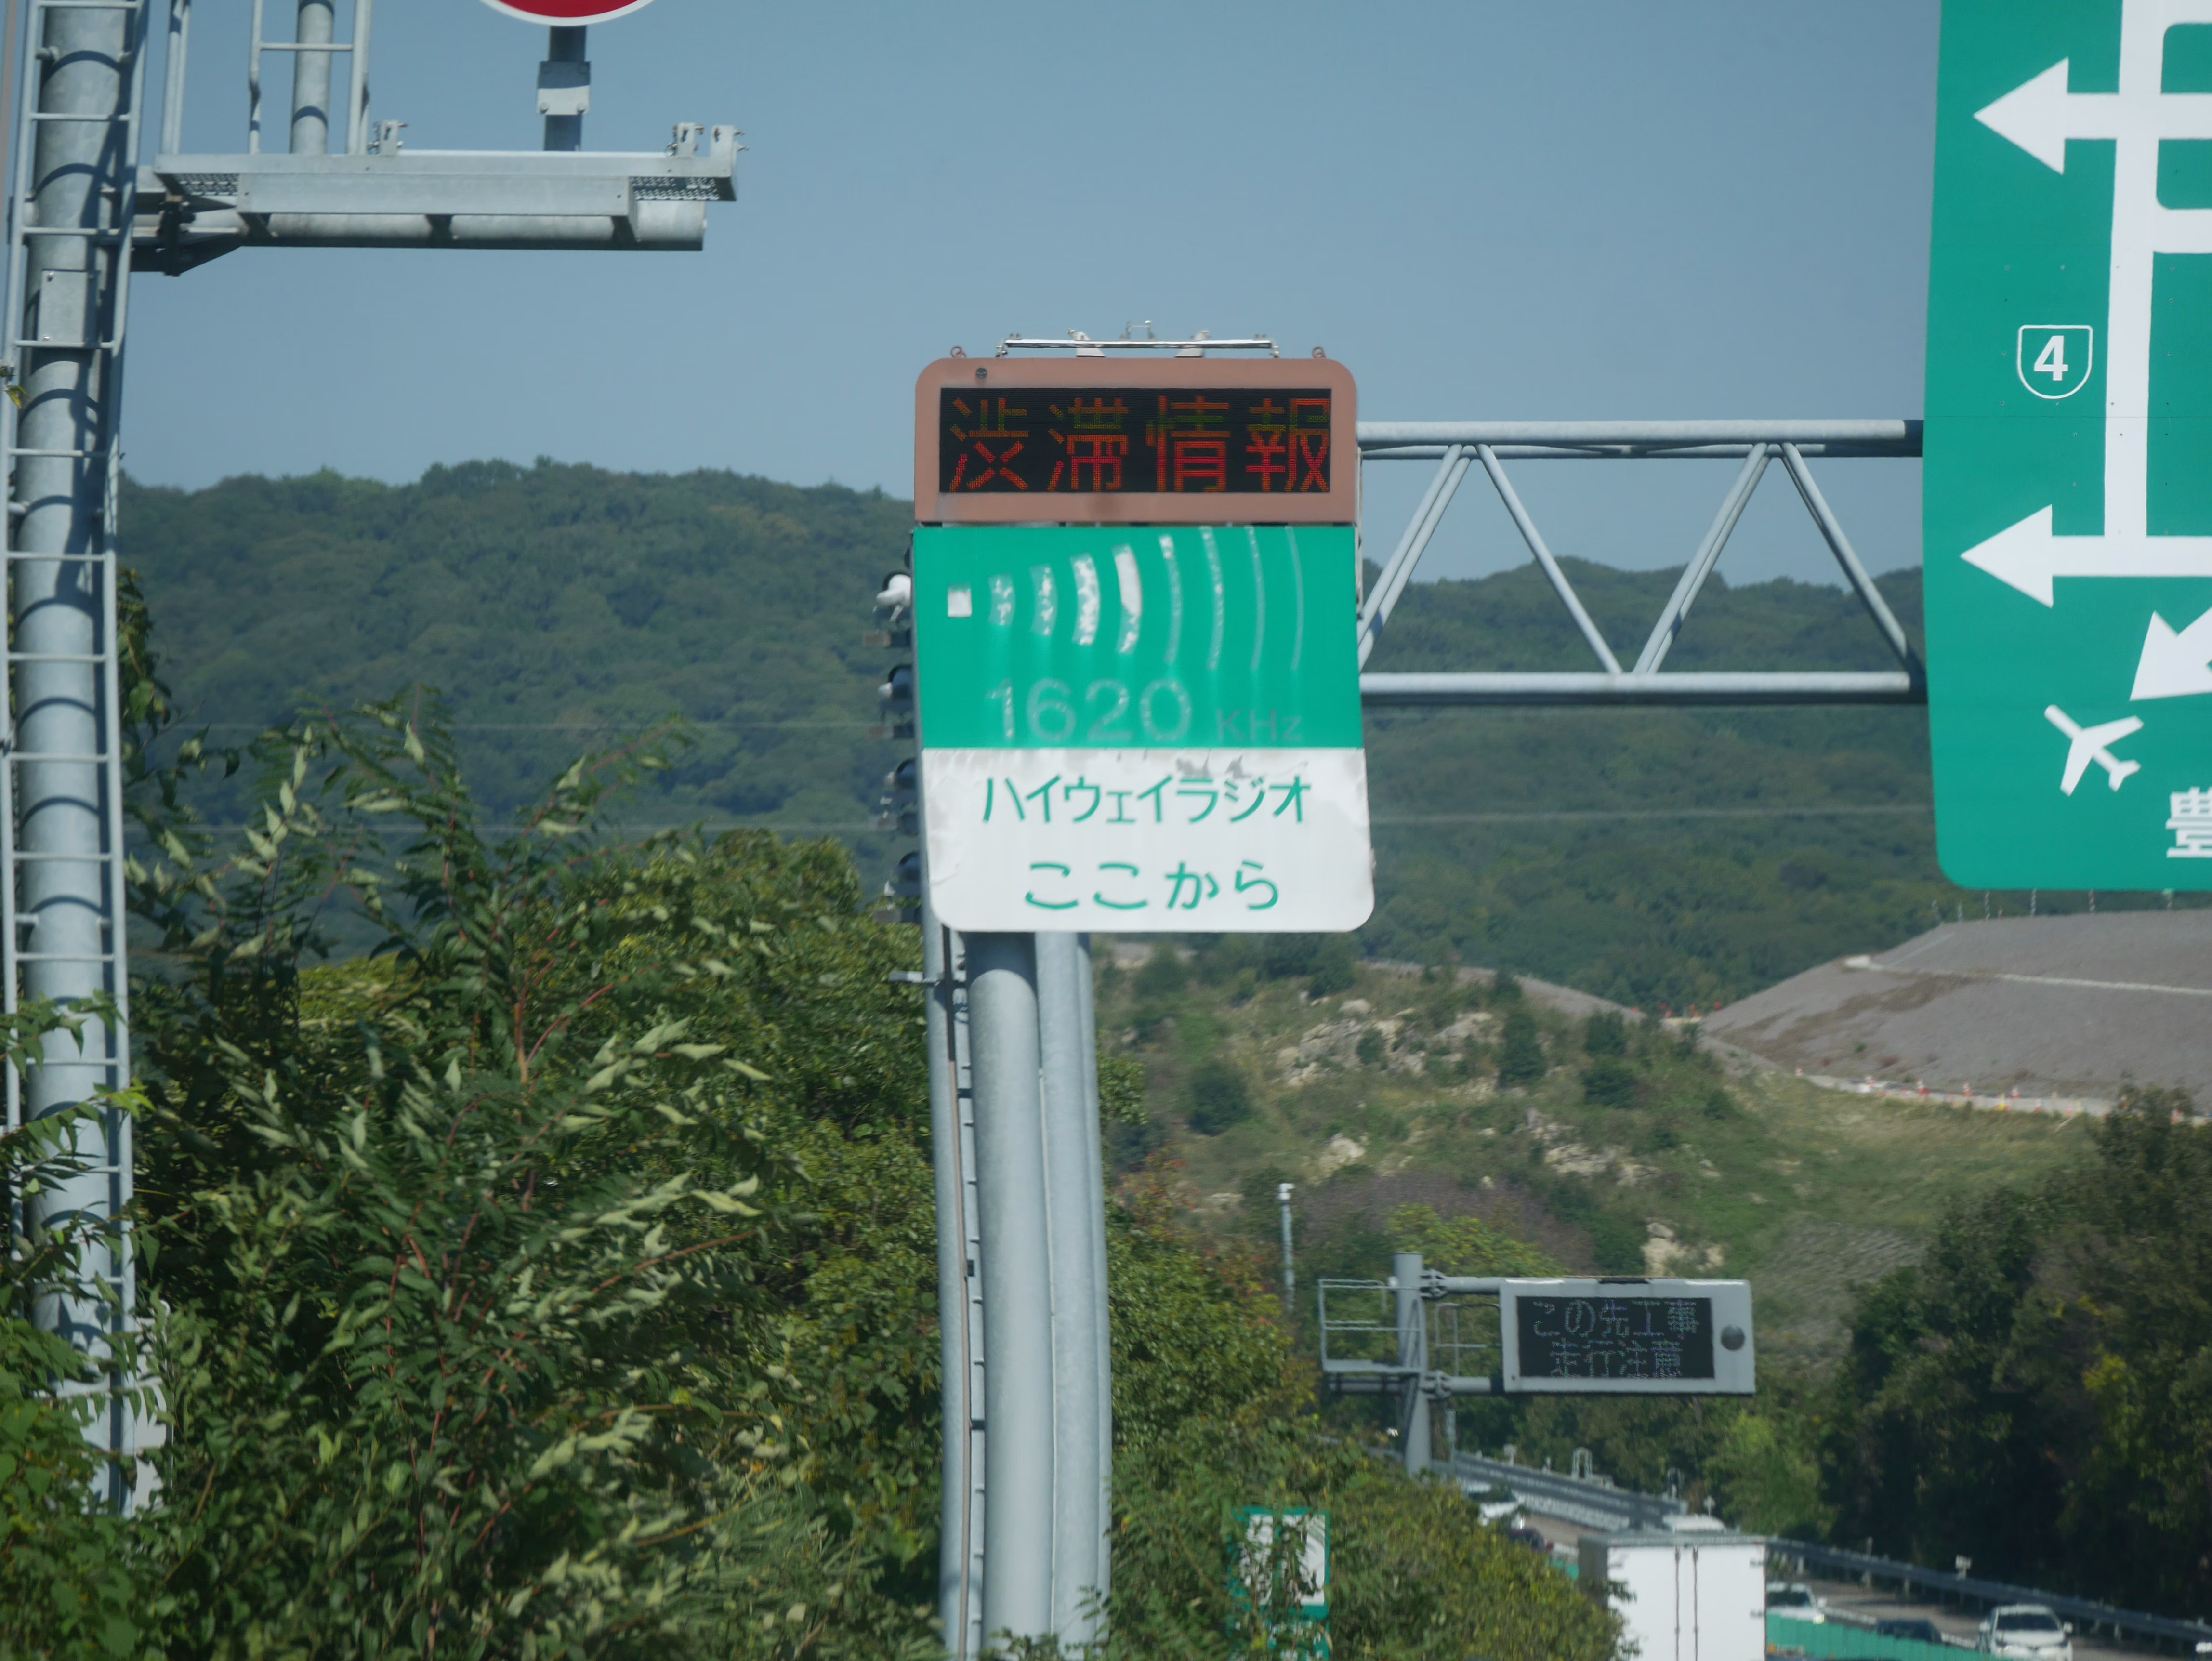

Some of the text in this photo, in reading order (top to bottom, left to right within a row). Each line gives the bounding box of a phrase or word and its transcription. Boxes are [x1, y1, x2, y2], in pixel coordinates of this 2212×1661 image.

[2034, 335, 2068, 381] 4
[950, 395, 1330, 492] 渋滞情報
[985, 678, 1192, 742] 1620
[983, 775, 1311, 823] ハイウェイラジオ
[1025, 860, 1279, 910] ここから
[1533, 1299, 1699, 1340] この先工事
[1550, 1337, 1683, 1379] 走行注意
